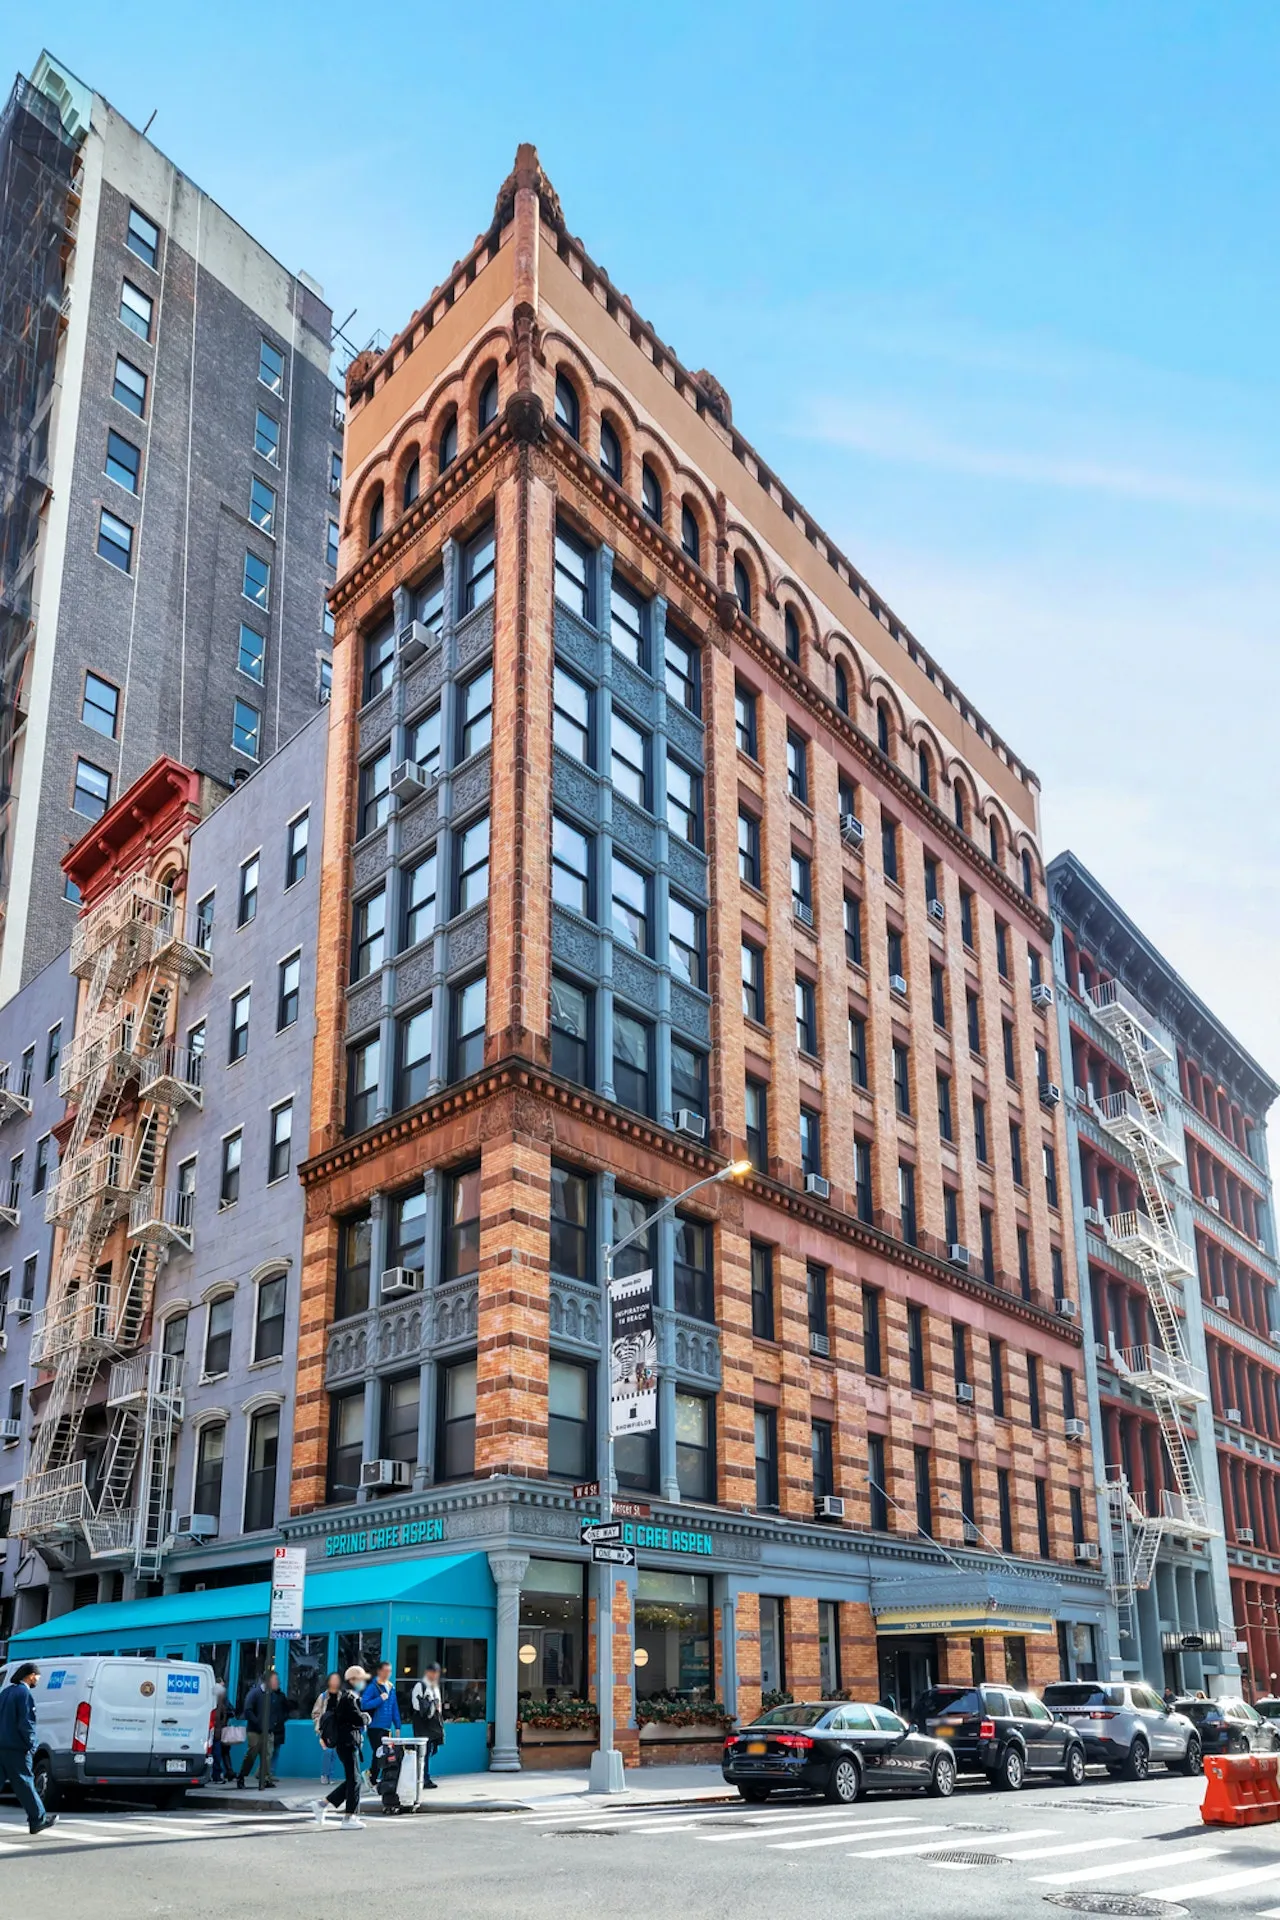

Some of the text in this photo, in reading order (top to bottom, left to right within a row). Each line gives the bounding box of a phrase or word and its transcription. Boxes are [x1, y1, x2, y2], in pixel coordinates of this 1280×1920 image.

[614, 1303, 650, 1318] INSPIRATION
[626, 1312, 647, 1323] REACH
[615, 1419, 652, 1431] SHOWFIELDS
[575, 1485, 582, 1497] W
[583, 1485, 589, 1496] 4
[611, 1502, 641, 1516] Mercer St
[325, 1518, 444, 1557] SPRING CAFE ASPEN
[587, 1527, 618, 1539] ONE WAY
[636, 1525, 669, 1549] CAFE
[672, 1530, 713, 1555] ASPEN
[598, 1549, 630, 1561] ONE WAY
[168, 1679, 198, 1689] KONE
